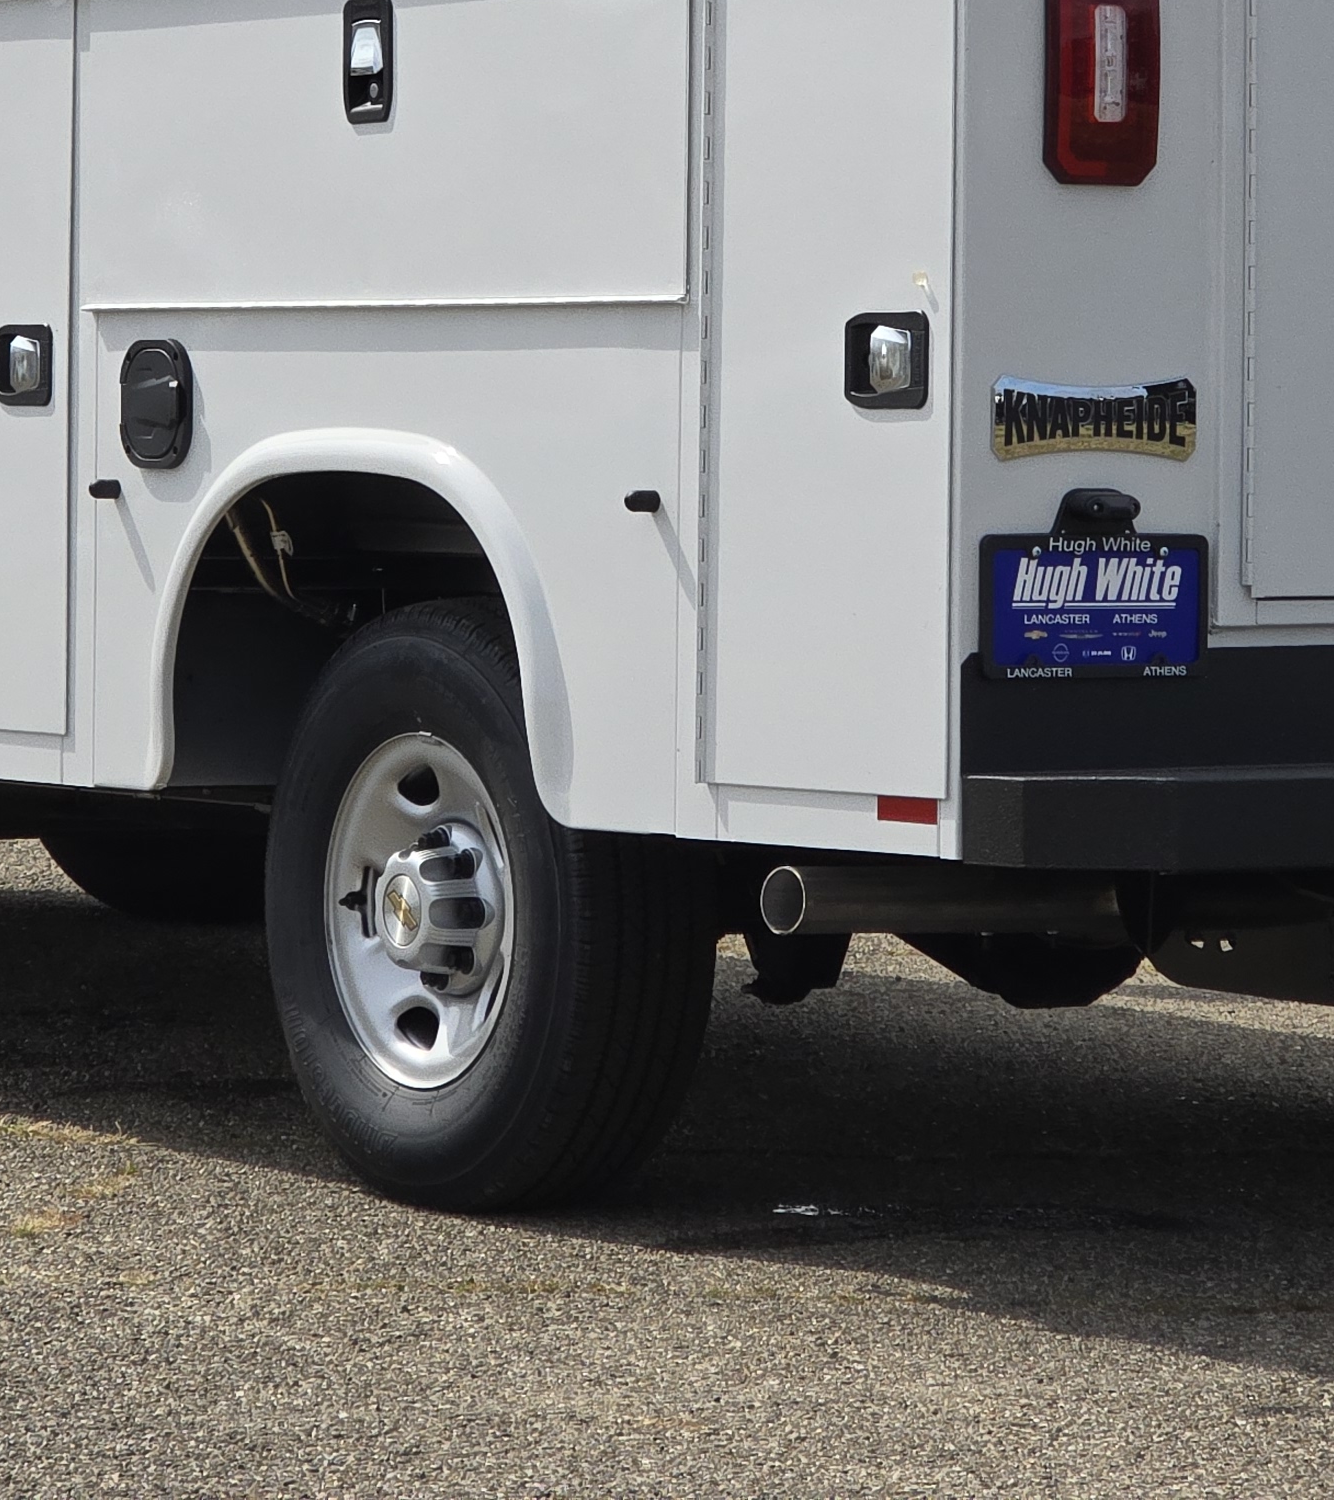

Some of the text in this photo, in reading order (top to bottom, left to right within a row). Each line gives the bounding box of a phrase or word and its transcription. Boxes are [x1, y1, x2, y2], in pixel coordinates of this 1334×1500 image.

[1004, 388, 1189, 447] KNAPHEIDE
[1049, 536, 1151, 555] Hugh White
[1012, 557, 1182, 609] Hugh White
[1024, 613, 1158, 625] LANCASTER ATHENS
[1007, 665, 1187, 678] LANCASTER ATHENS
